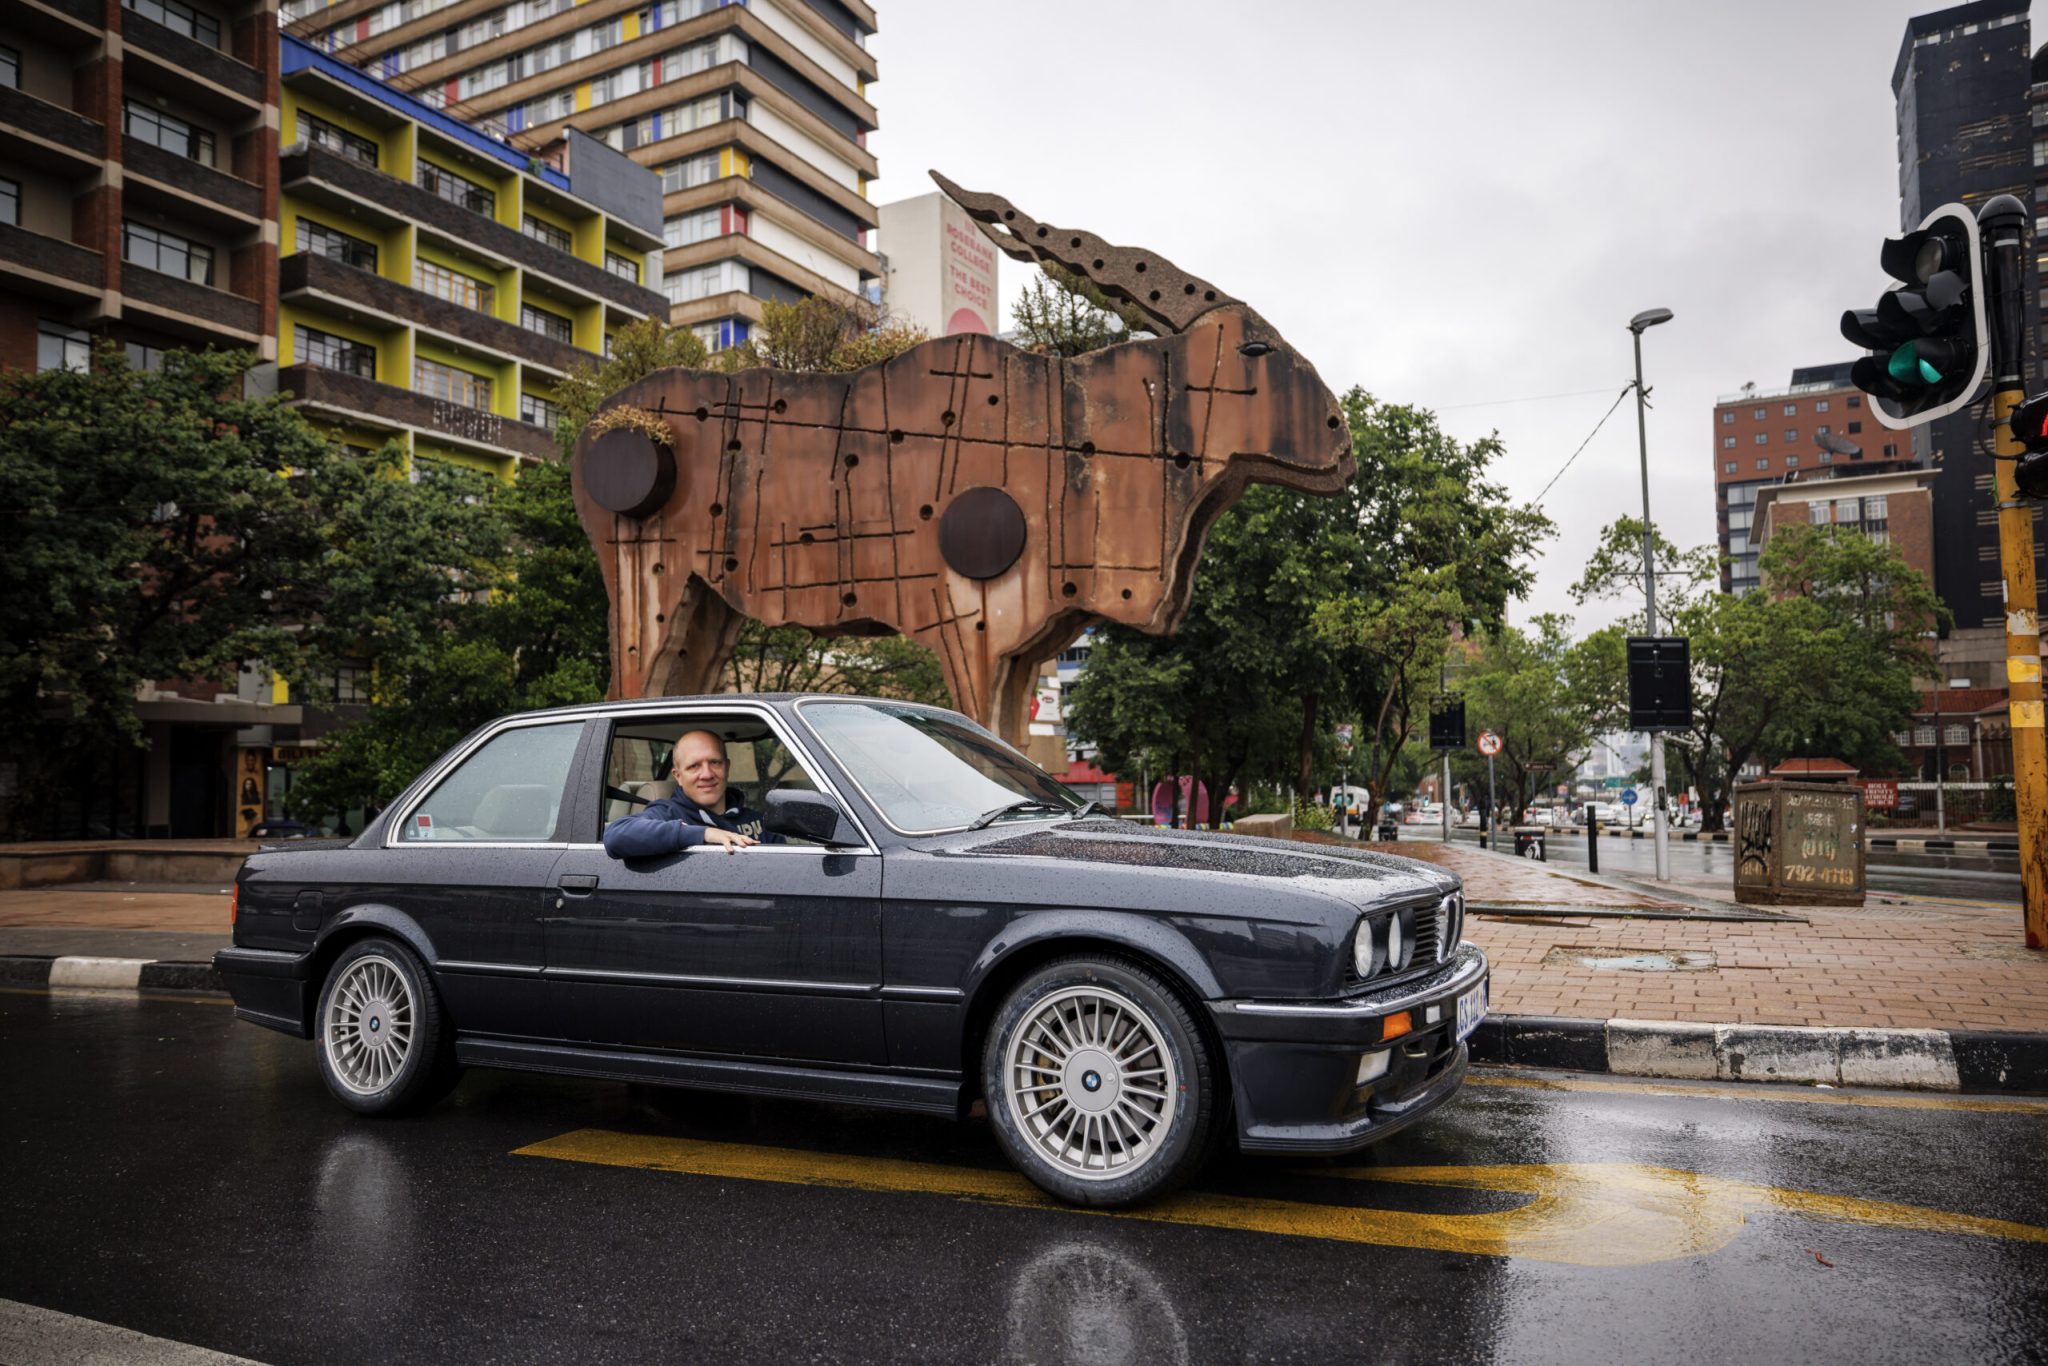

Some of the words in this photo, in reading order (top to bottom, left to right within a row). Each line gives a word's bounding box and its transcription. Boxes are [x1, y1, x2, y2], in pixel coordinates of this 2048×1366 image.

[946, 223, 993, 262] ROSEBANK
[950, 241, 990, 274] COLLEGE
[950, 264, 967, 284] THE
[970, 274, 992, 297] BEST
[955, 284, 987, 310] CHOICE
